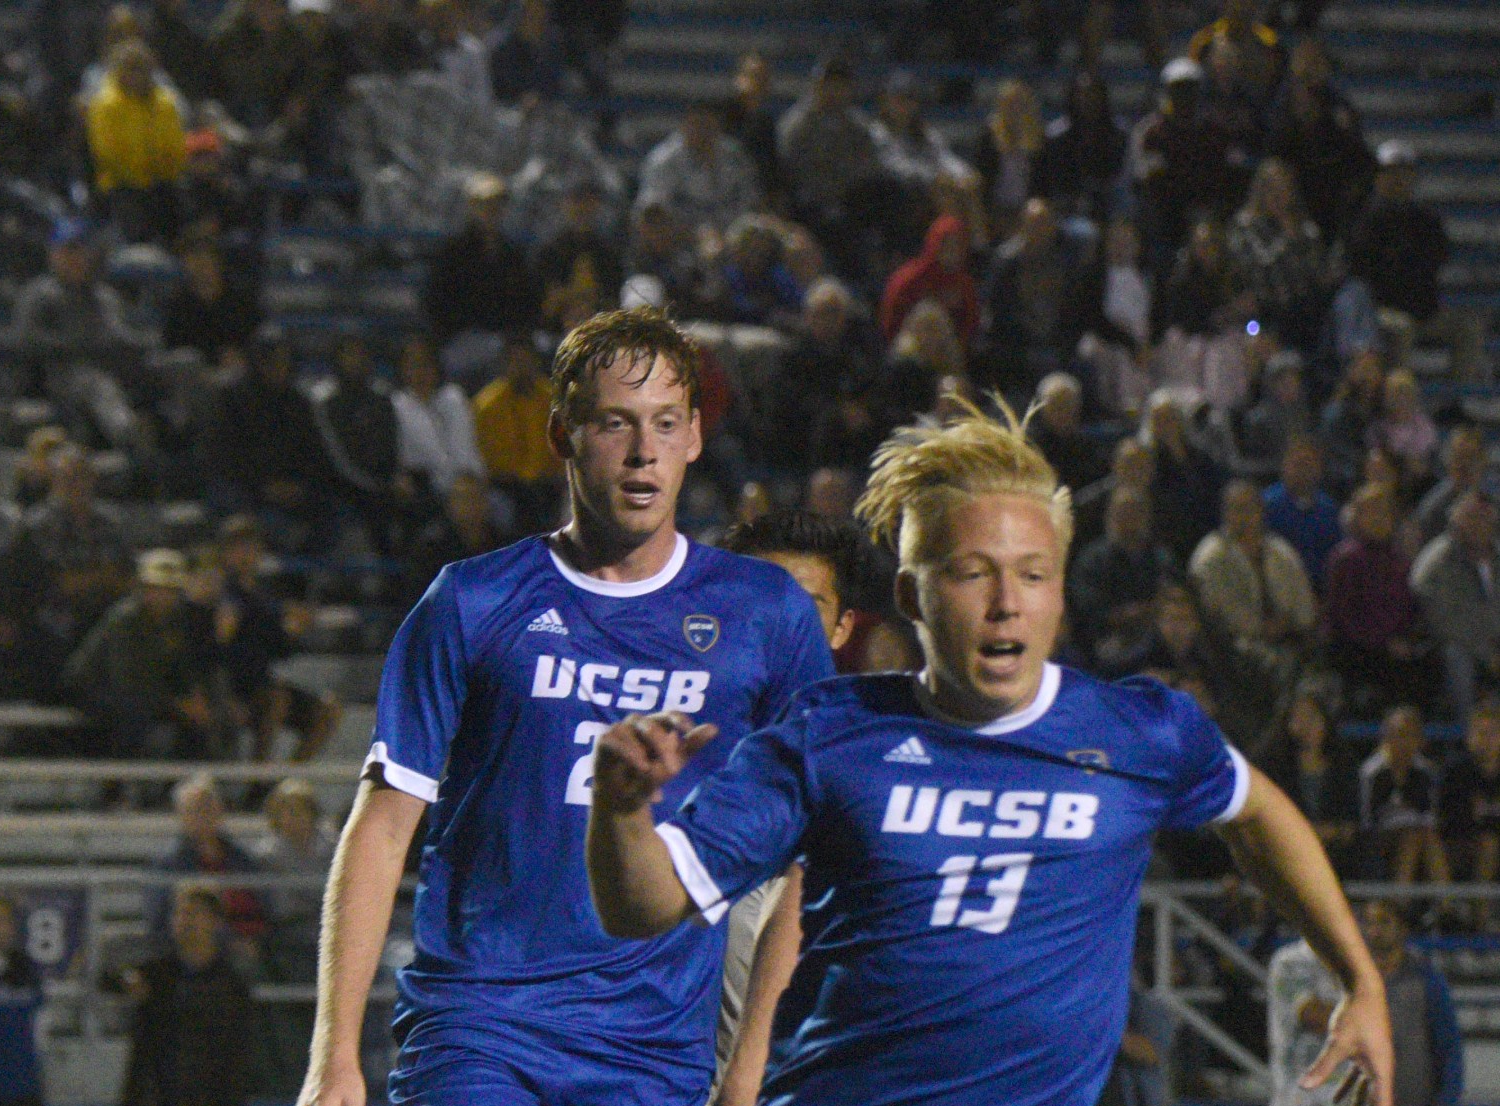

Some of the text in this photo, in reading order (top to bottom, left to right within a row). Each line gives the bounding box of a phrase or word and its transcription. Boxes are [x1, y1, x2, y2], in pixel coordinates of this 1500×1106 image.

[527, 623, 569, 636] adidas
[531, 655, 711, 714] UCSB
[880, 784, 1100, 840] UCSB
[929, 853, 1034, 934] 13
[25, 908, 66, 963] 8
